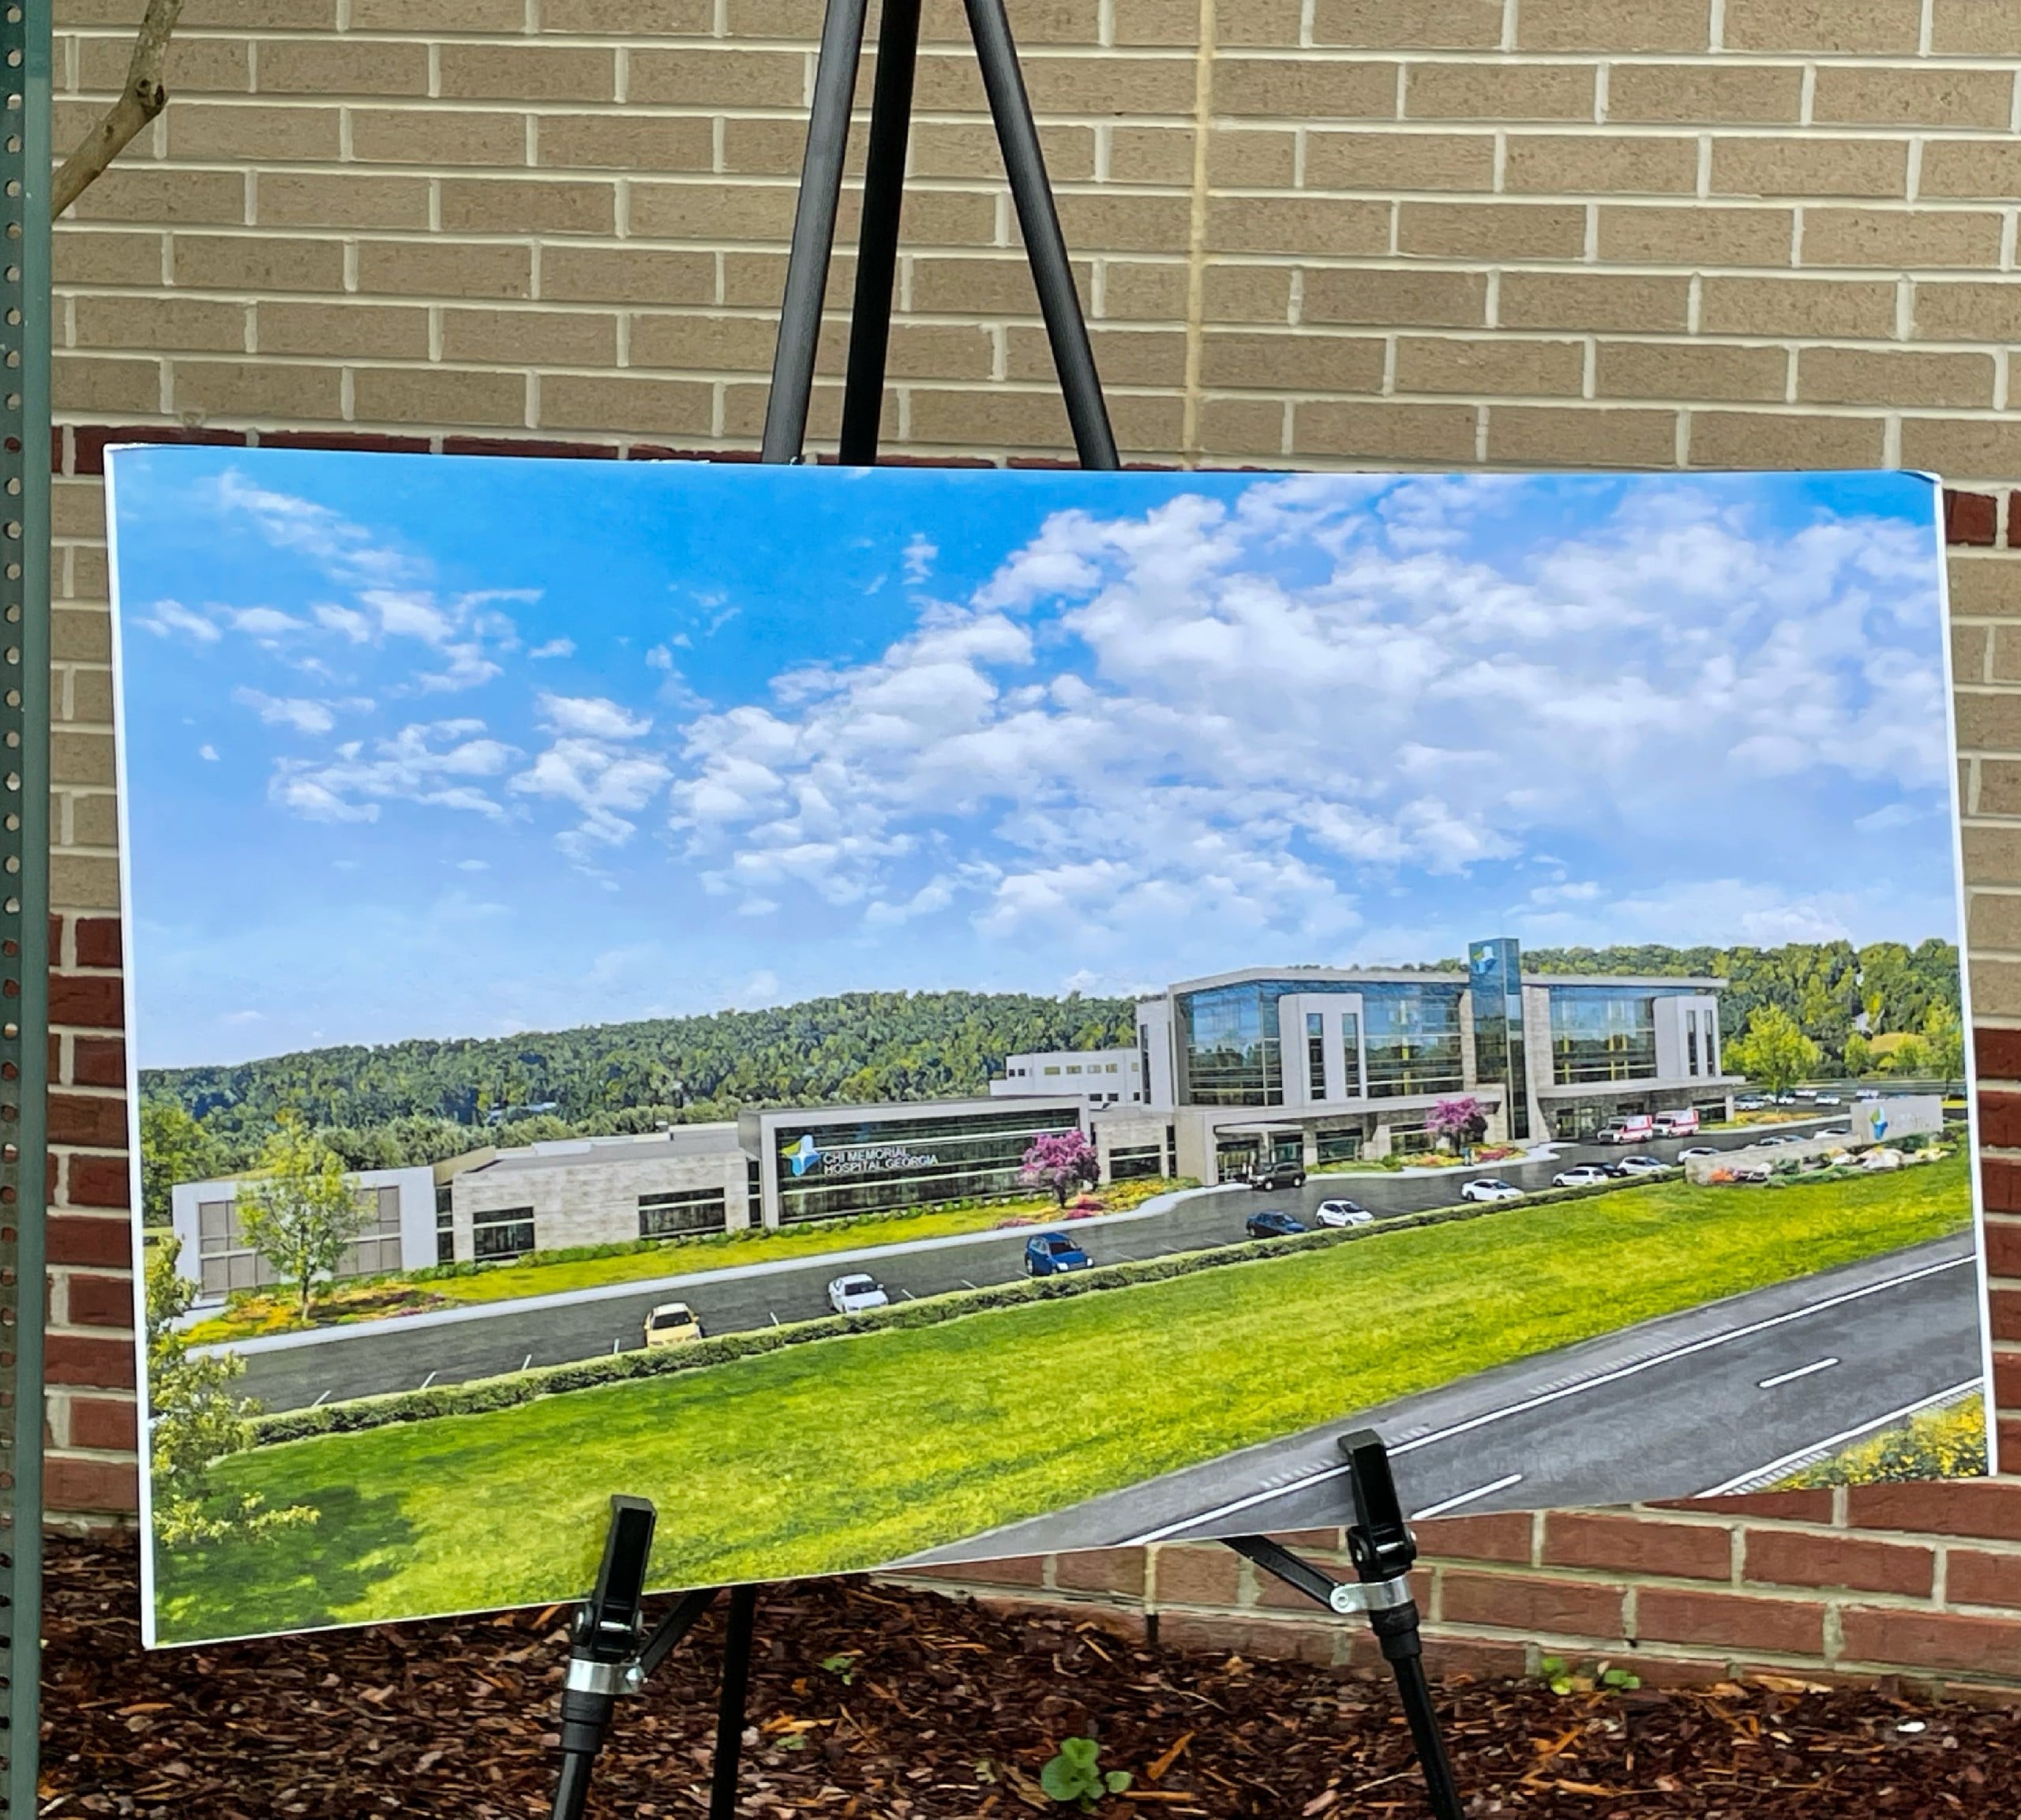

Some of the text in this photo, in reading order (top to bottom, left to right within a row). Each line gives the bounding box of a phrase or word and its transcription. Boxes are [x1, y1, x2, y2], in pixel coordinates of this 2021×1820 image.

[823, 1146, 909, 1165] CHI MEMORIAL
[824, 1154, 939, 1175] HOSPITAL GEORGIA
